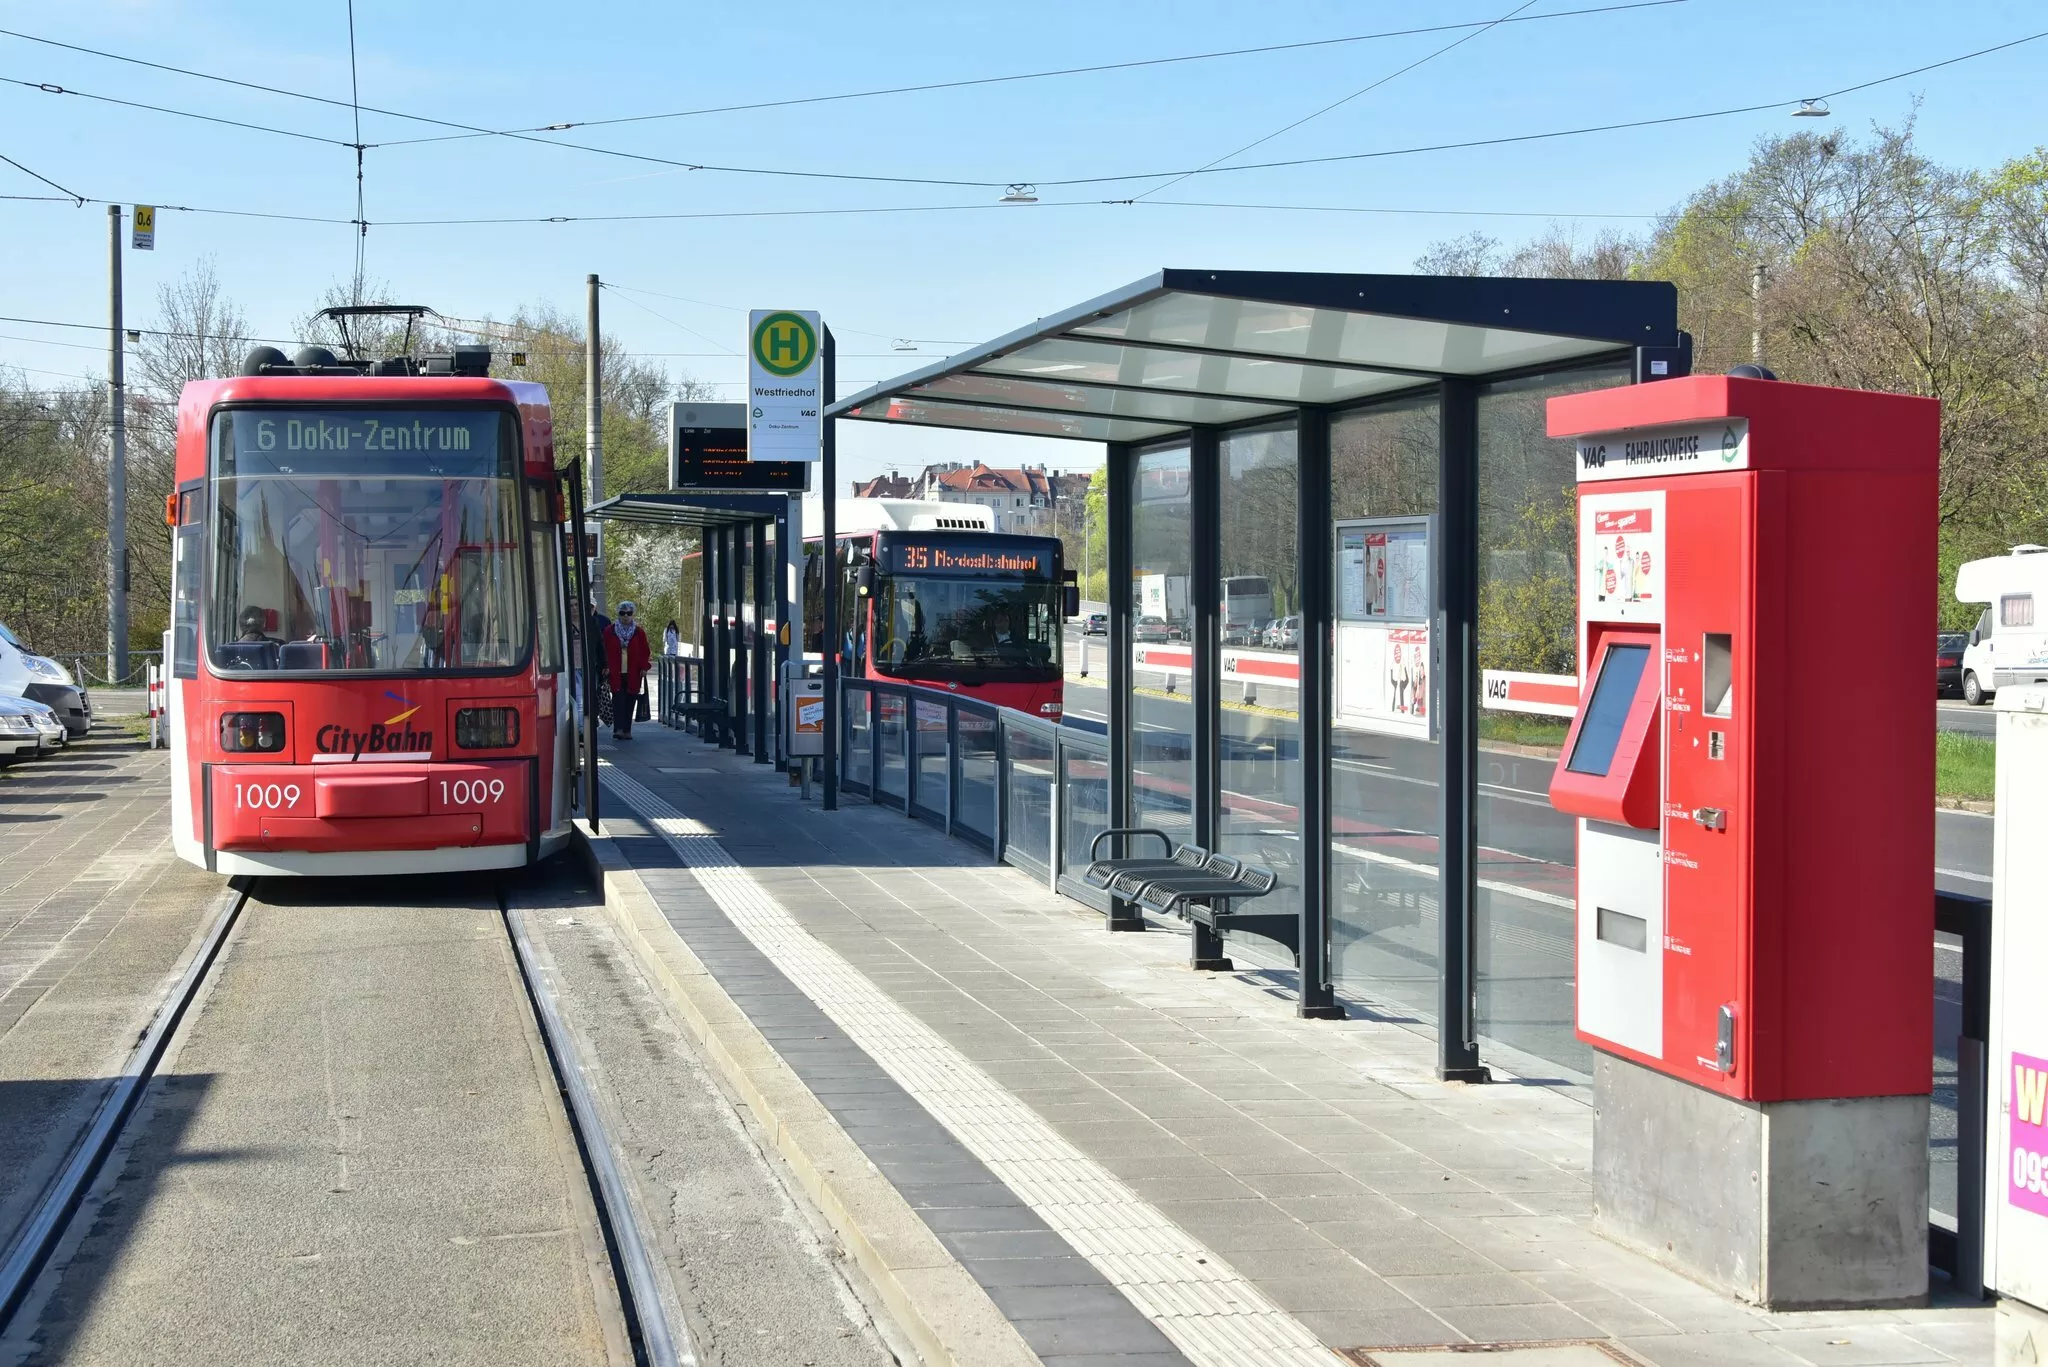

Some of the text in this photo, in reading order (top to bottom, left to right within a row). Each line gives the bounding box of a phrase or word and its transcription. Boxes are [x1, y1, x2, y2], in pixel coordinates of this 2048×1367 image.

[137, 211, 152, 227] 0,6
[770, 327, 800, 361] H
[754, 387, 816, 397] Westfriedhof
[257, 419, 470, 451] 6 Doku-Zentrum
[1583, 435, 1699, 469] VAG FAHRAUSWEISE
[904, 546, 928, 568] 35
[1135, 650, 1145, 664] VAG
[1223, 657, 1236, 673] VAG
[1487, 678, 1507, 699] VAG
[316, 721, 433, 762] CityBahn
[234, 783, 301, 809] 1009
[439, 779, 505, 805] 1009
